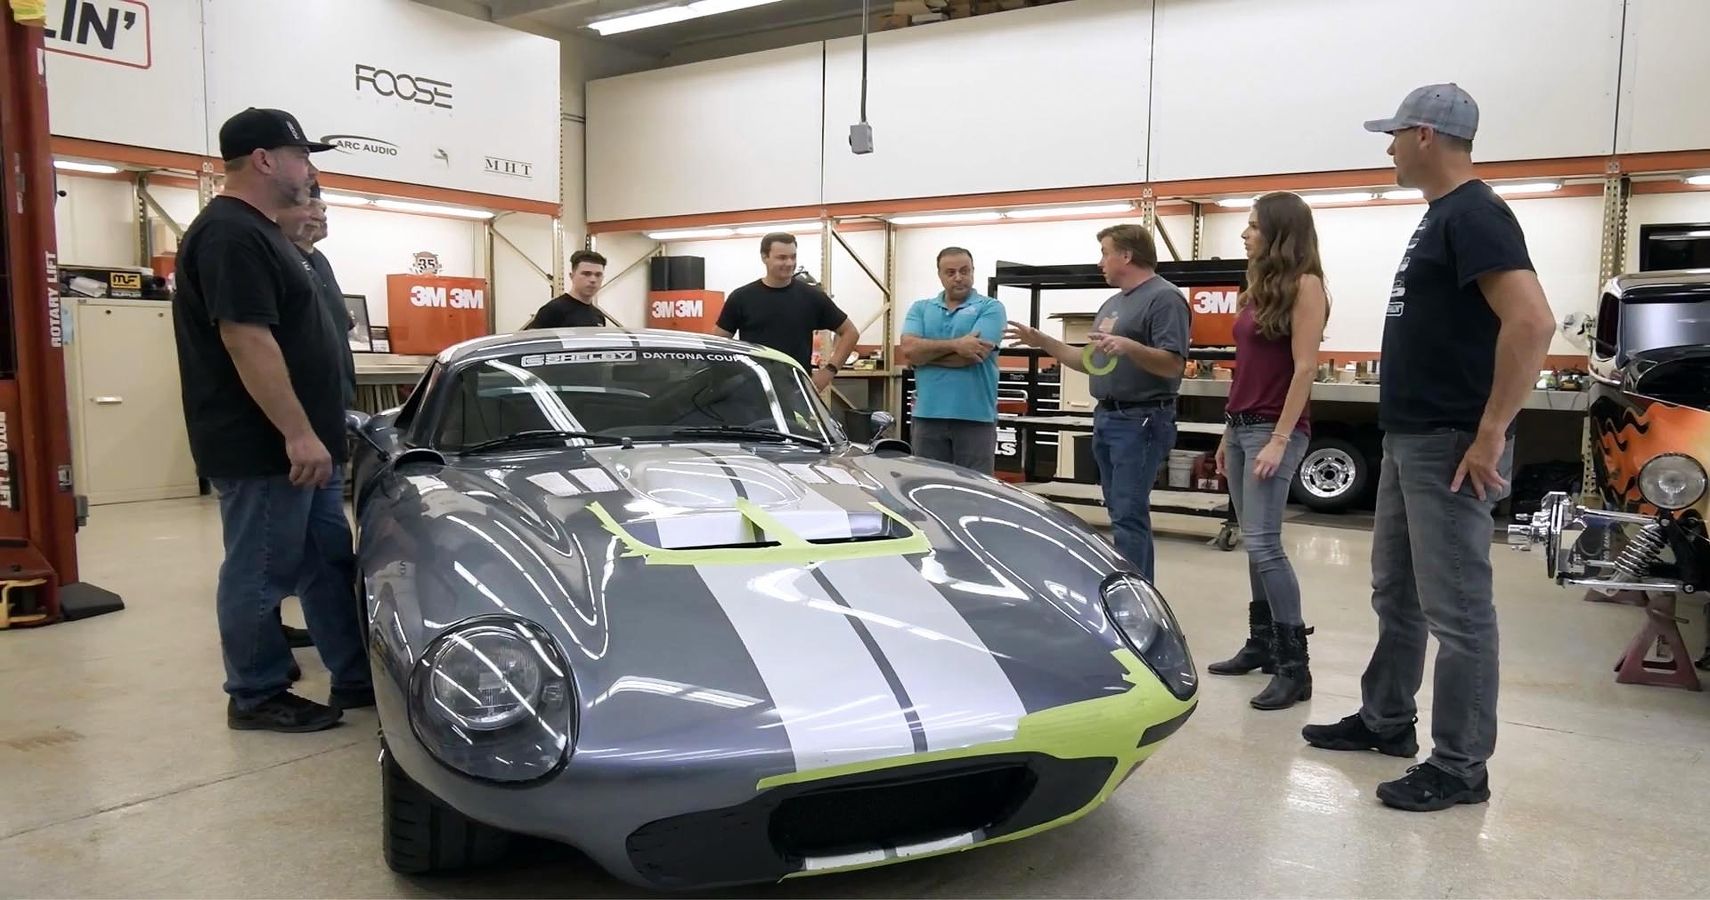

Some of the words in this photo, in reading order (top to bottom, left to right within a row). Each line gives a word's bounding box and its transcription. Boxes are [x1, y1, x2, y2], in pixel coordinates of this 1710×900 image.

[44, 0, 136, 50] IN'
[356, 64, 452, 109] FOOSE
[337, 140, 360, 150] ARC
[363, 144, 397, 156] AUDIO
[45, 251, 57, 284] LIFT
[418, 258, 436, 271] 35
[410, 285, 447, 308] 3M
[449, 287, 484, 309] 3M
[1193, 291, 1238, 314] 3M
[48, 288, 61, 348] ROTARY
[652, 301, 674, 318] 3M
[675, 300, 703, 318] 3M
[545, 350, 637, 365] SHELBY
[642, 352, 705, 361] DAYTONA
